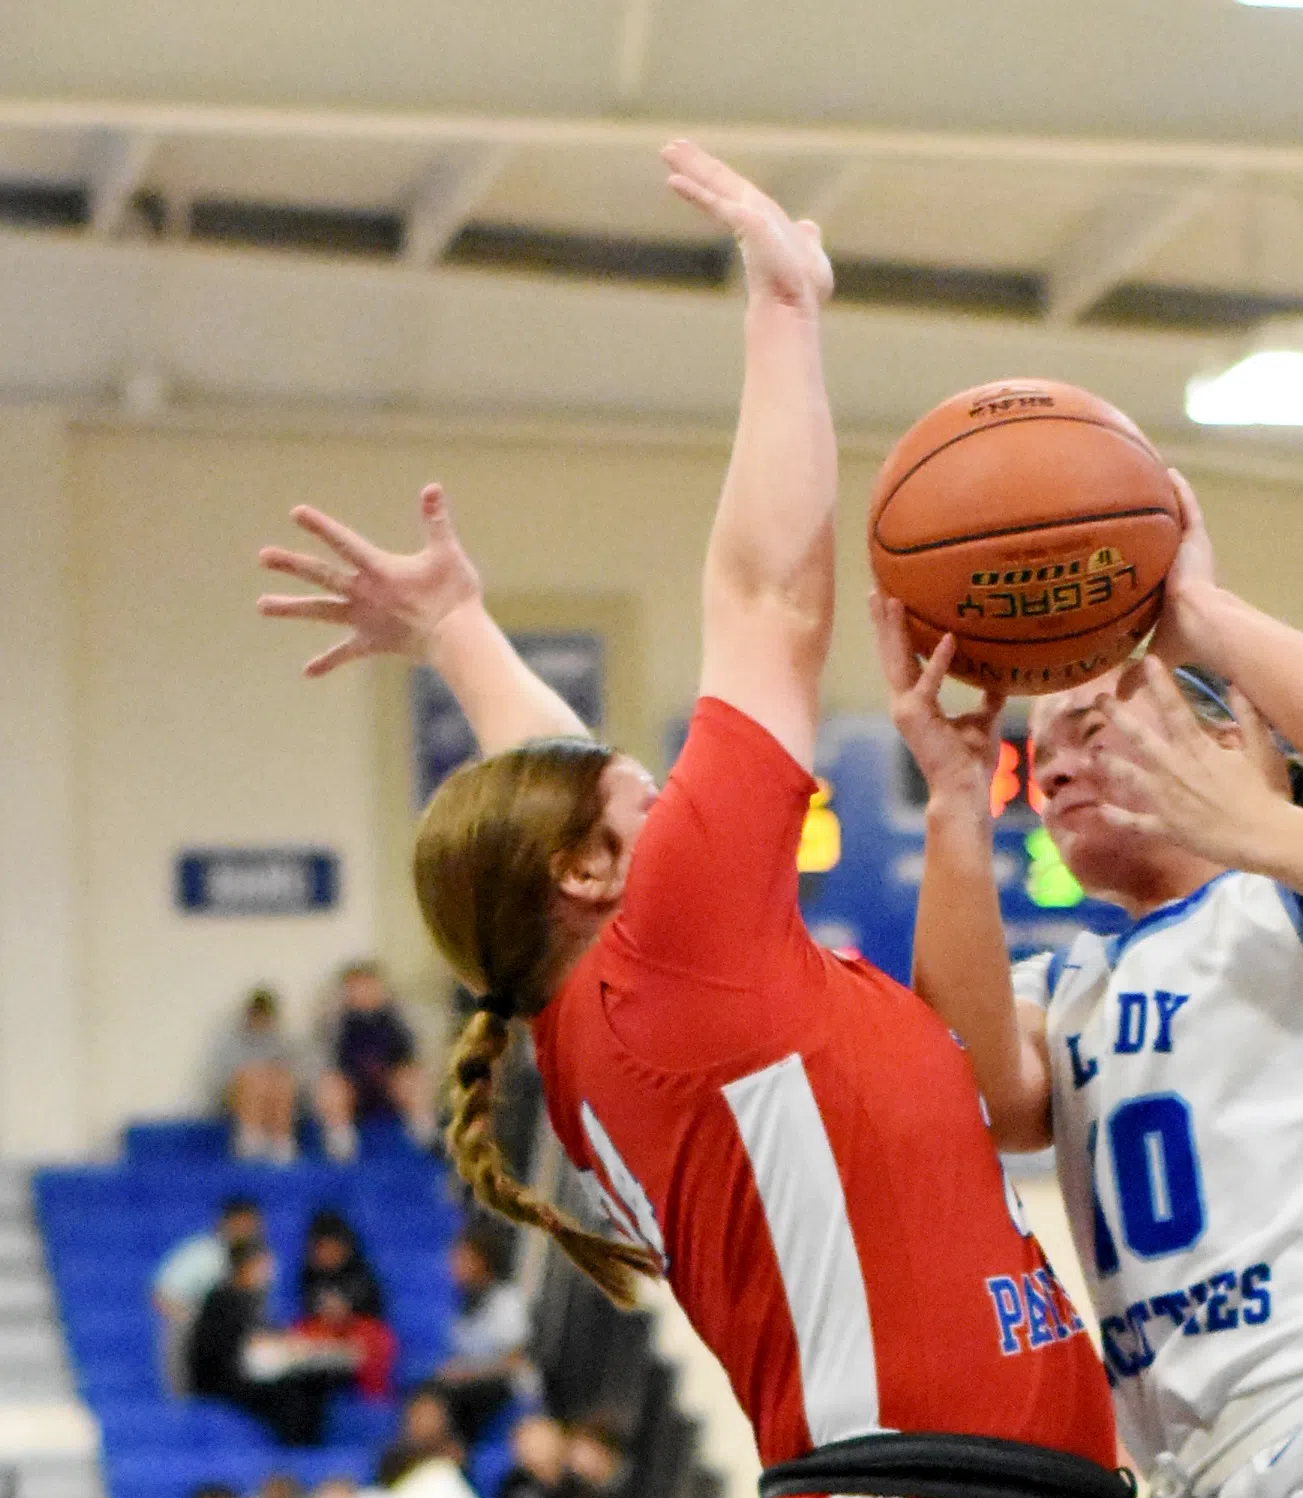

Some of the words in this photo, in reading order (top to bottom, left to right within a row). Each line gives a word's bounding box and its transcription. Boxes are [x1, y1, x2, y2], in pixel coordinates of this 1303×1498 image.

[956, 564, 1138, 619] LEGACY
[970, 559, 1081, 587] 1000
[1065, 988, 1190, 1091] LDY
